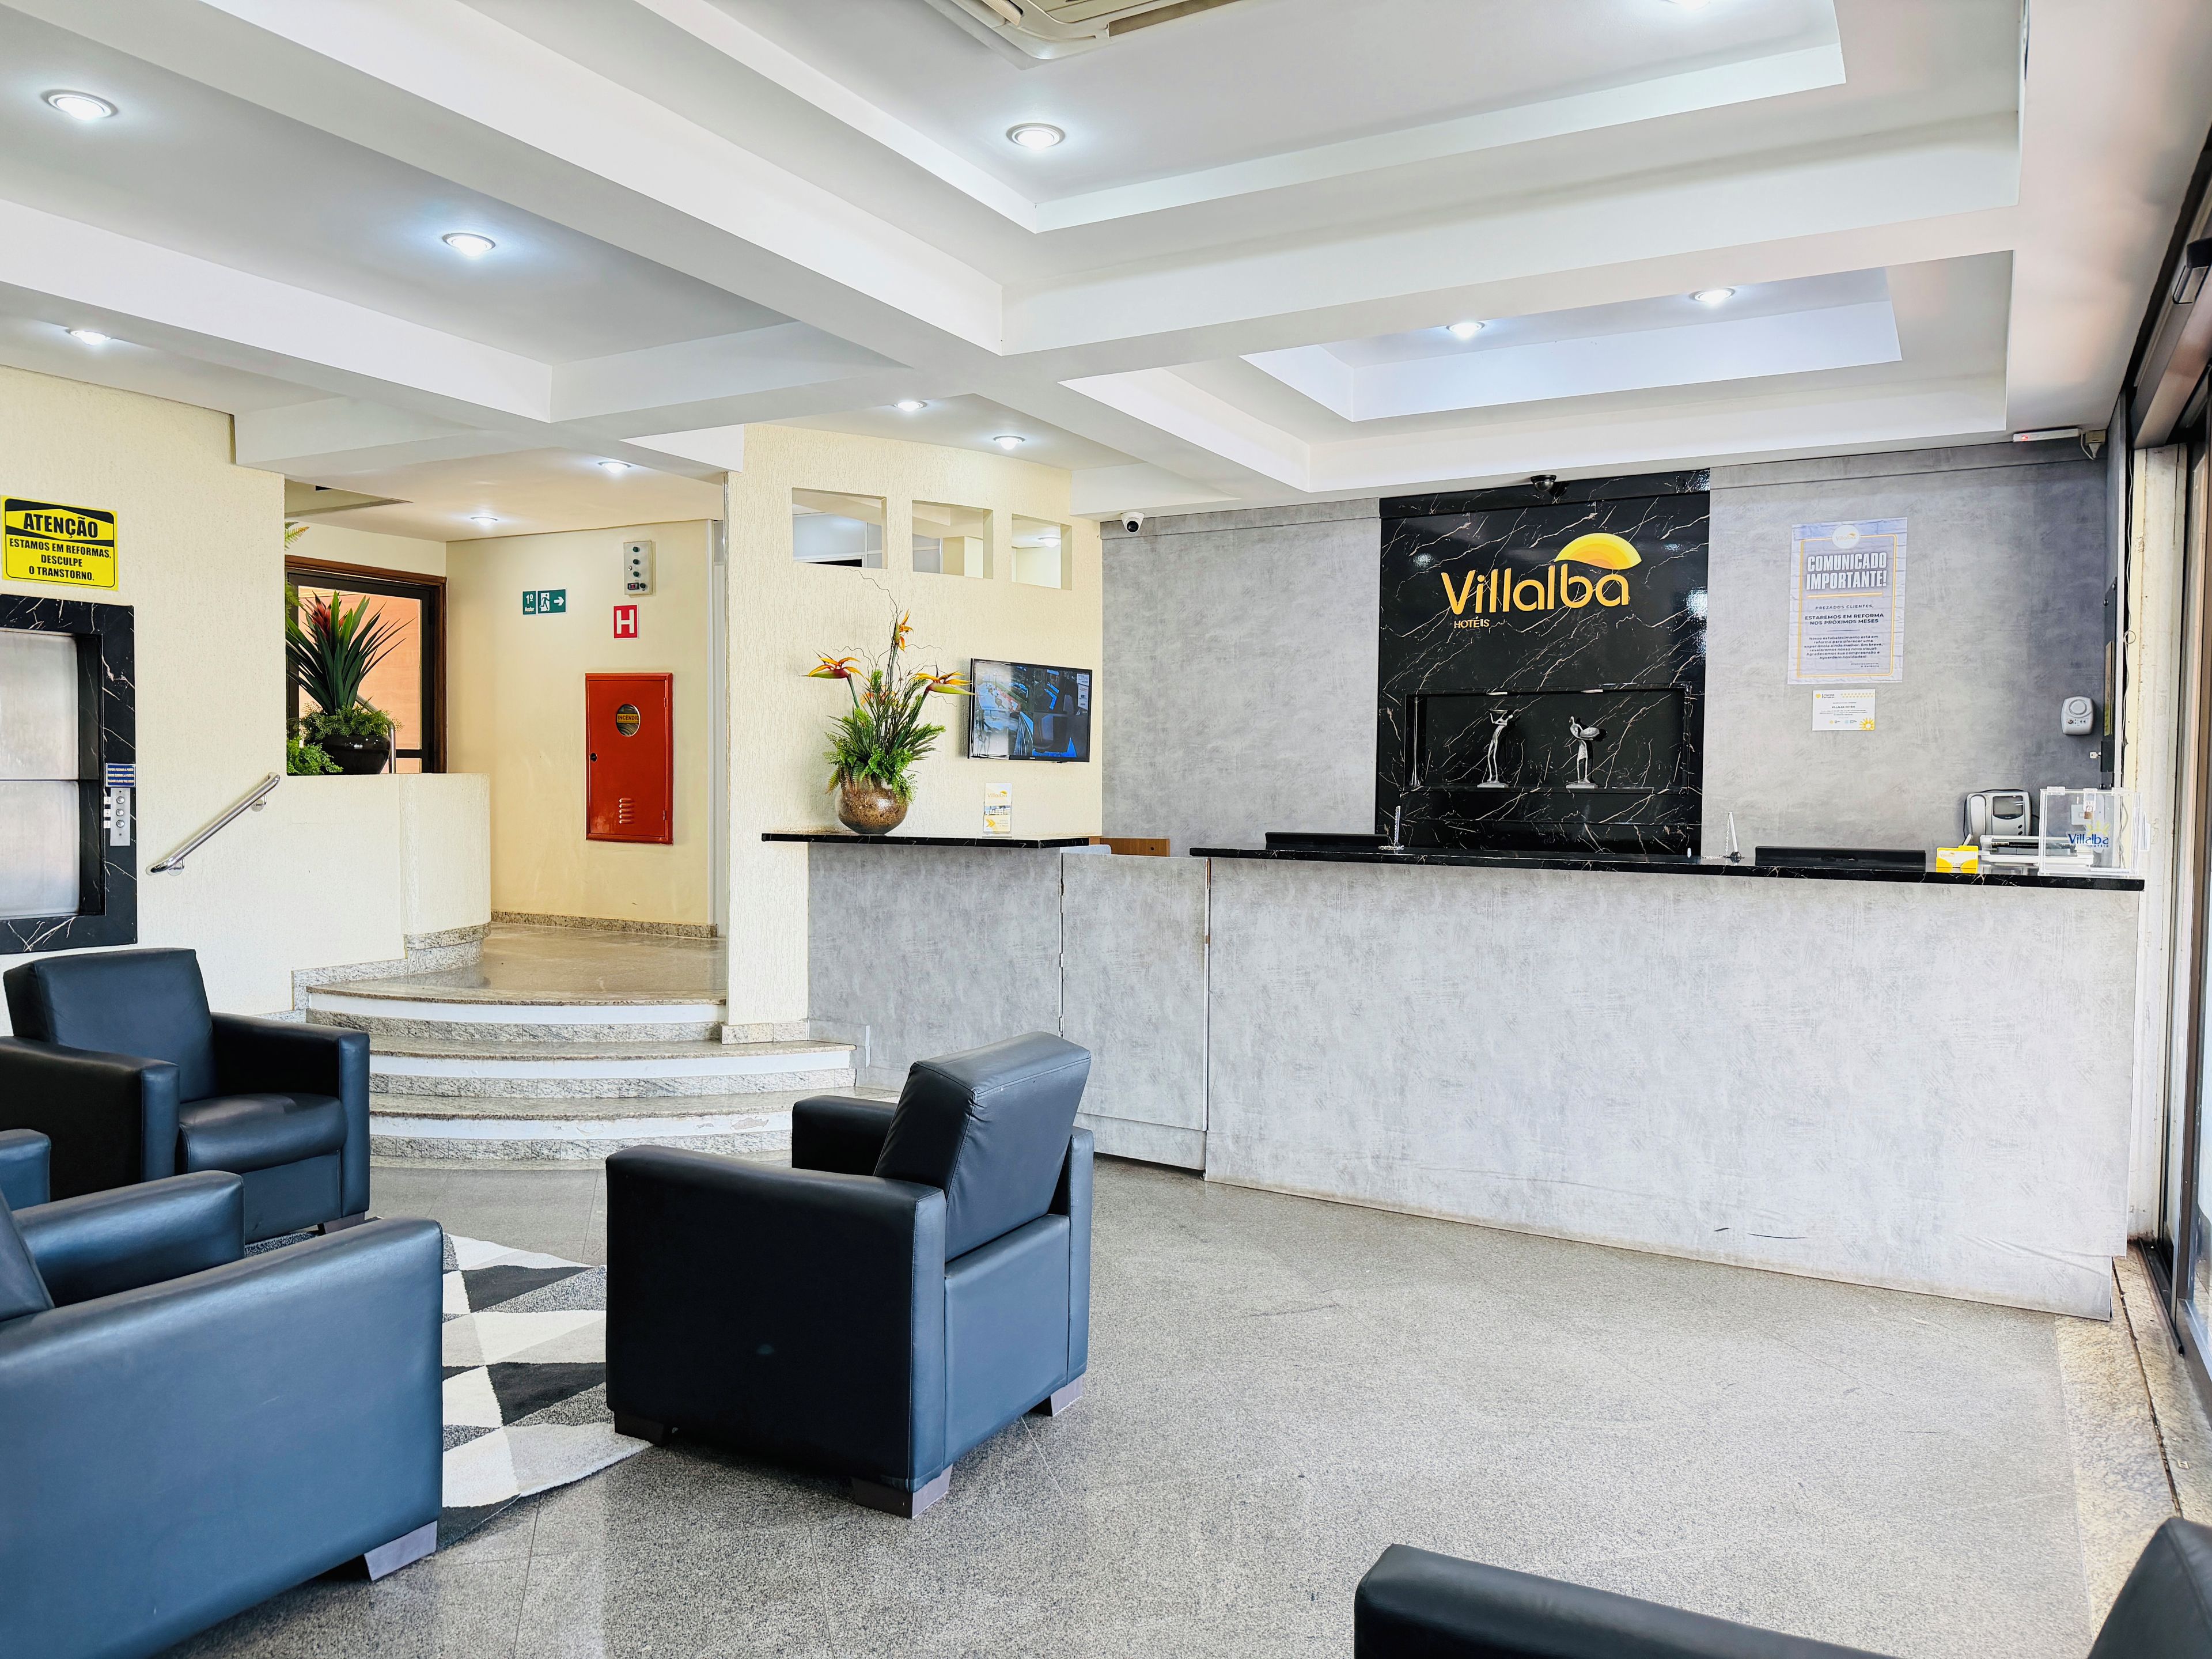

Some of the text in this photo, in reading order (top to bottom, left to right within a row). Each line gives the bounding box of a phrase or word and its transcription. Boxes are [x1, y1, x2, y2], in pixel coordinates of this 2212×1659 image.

[24, 513, 98, 538] ATENÇÃO
[10, 538, 111, 559] ESTAMOS EM REFORMAS,
[41, 555, 82, 567] DESCULPE
[1808, 552, 1887, 572] COMUNICADO
[29, 566, 94, 581] O TRANSTORNO.
[1806, 570, 1887, 590] IMPORTANTE!
[526, 594, 533, 604] 1º
[1441, 563, 1628, 615] Villalba
[616, 609, 634, 634] H
[1454, 616, 1490, 629] HOTÉIS
[2068, 834, 2108, 844] Villalba
